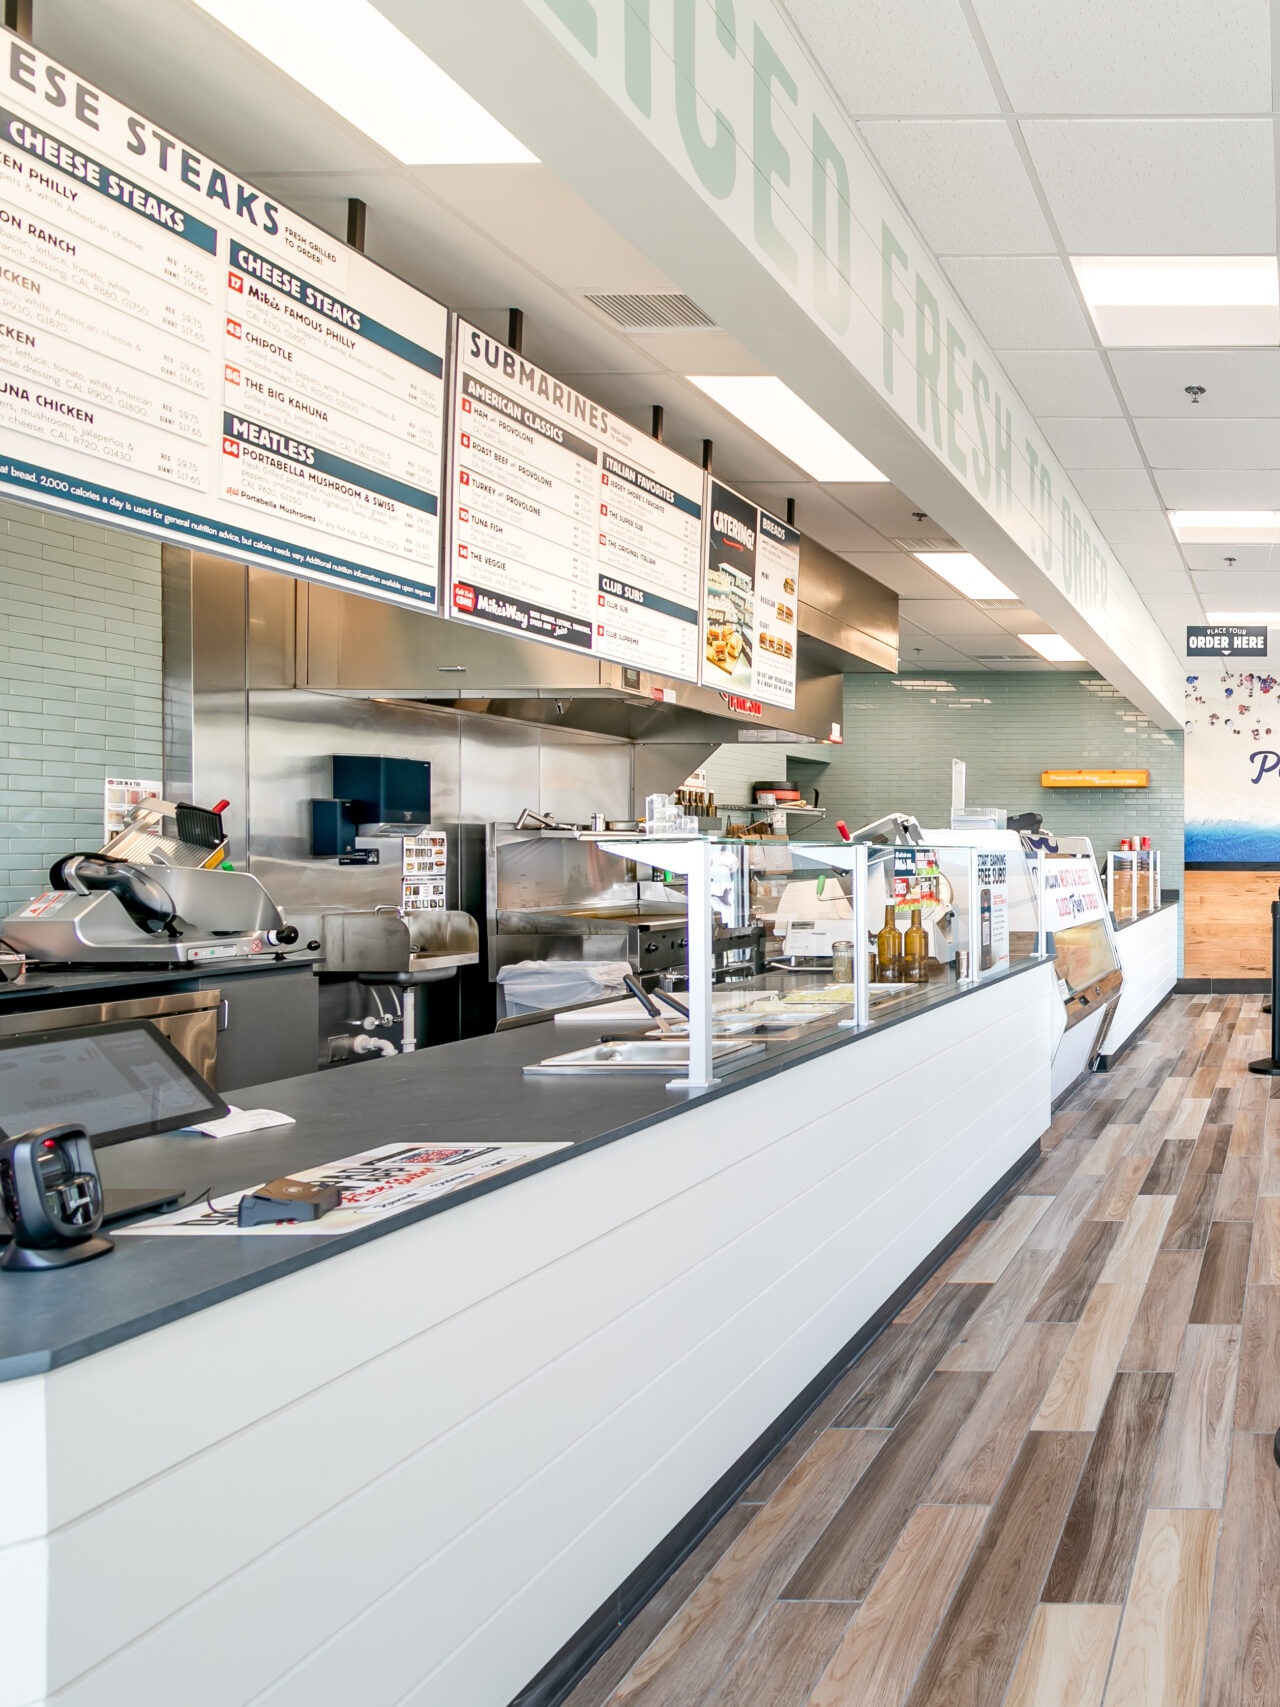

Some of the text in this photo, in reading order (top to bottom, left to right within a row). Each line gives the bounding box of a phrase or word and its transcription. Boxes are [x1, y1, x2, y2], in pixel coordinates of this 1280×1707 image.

[9, 120, 185, 233] CHEESE STEAKS
[29, 168, 79, 203] PHILLY
[126, 116, 280, 236] STEAKS
[67, 205, 110, 234] American
[27, 224, 77, 257] RANCH
[284, 226, 337, 263] FRESH GRILLED
[284, 238, 324, 265] TO ORDER!
[72, 273, 91, 290] CAL
[236, 249, 302, 302] CHEESE
[304, 287, 362, 332] STEAKS
[55, 308, 99, 335] American
[248, 285, 281, 311] Mike's
[283, 306, 324, 333] FAMOUS
[326, 328, 357, 352] PHILLY
[245, 332, 295, 364] CHIPOTLE
[66, 379, 84, 394] CAL
[471, 331, 609, 435] SUBMARINES
[881, 219, 1013, 513] FRESH
[1025, 436, 1052, 572] TO
[36, 394, 94, 425] CHICKEN
[244, 377, 329, 423] THE BIG KAHUNA
[468, 380, 522, 421] AMERICAN
[524, 412, 564, 444] CLASSICS
[50, 428, 69, 444] CAL
[473, 406, 489, 420] HAM
[498, 419, 535, 445] PROVOLONE
[232, 418, 316, 466] MEATLESS
[242, 447, 396, 513] PORTABELLA MUSHROOM & SWISS
[472, 441, 492, 459] ROAST
[494, 453, 509, 466] BEEF
[518, 464, 553, 489] PROVOLONE
[606, 458, 636, 483] ITALIAN
[637, 472, 675, 503] FAVORITES
[241, 491, 316, 524] Portabella Mushrooms
[471, 478, 497, 496] TURKEY
[506, 494, 541, 517] PROVOLONE
[610, 479, 626, 493] JERSEY
[645, 498, 665, 514] FAVORITE
[11, 466, 38, 485] bread.
[40, 475, 69, 493] 2,000
[71, 484, 101, 503] calories
[109, 496, 124, 513] day
[133, 503, 151, 518] used
[152, 507, 163, 520] for
[164, 512, 191, 530] general
[191, 520, 218, 537] nutrition
[218, 526, 241, 544] advice,
[241, 533, 253, 546] but
[253, 538, 273, 553] calorie
[273, 544, 292, 559] needs
[291, 550, 306, 564] vary.
[306, 552, 333, 571] Additional
[332, 561, 354, 577] nutrition
[353, 567, 382, 584] information
[380, 575, 403, 591] available
[402, 581, 415, 595] upon
[471, 515, 504, 535] TUNA FISH
[609, 510, 644, 532] THE SUPER SUB
[713, 509, 755, 551] CATERING!
[762, 518, 786, 541] BREADS
[470, 551, 507, 572] THE VEGGIE
[608, 539, 617, 549] THE
[618, 543, 639, 560] ORIGINAL
[456, 595, 473, 607] COME
[602, 577, 644, 603] CLUB SUBS
[606, 600, 629, 614] CLUB SUB
[606, 629, 639, 646] CLUB SUPREME
[1189, 636, 1265, 649] ORDER HERE
[1207, 627, 1247, 635] PLACE YOUR
[977, 854, 1006, 868] START EARNING
[977, 867, 1007, 886] FREE SUBS!
